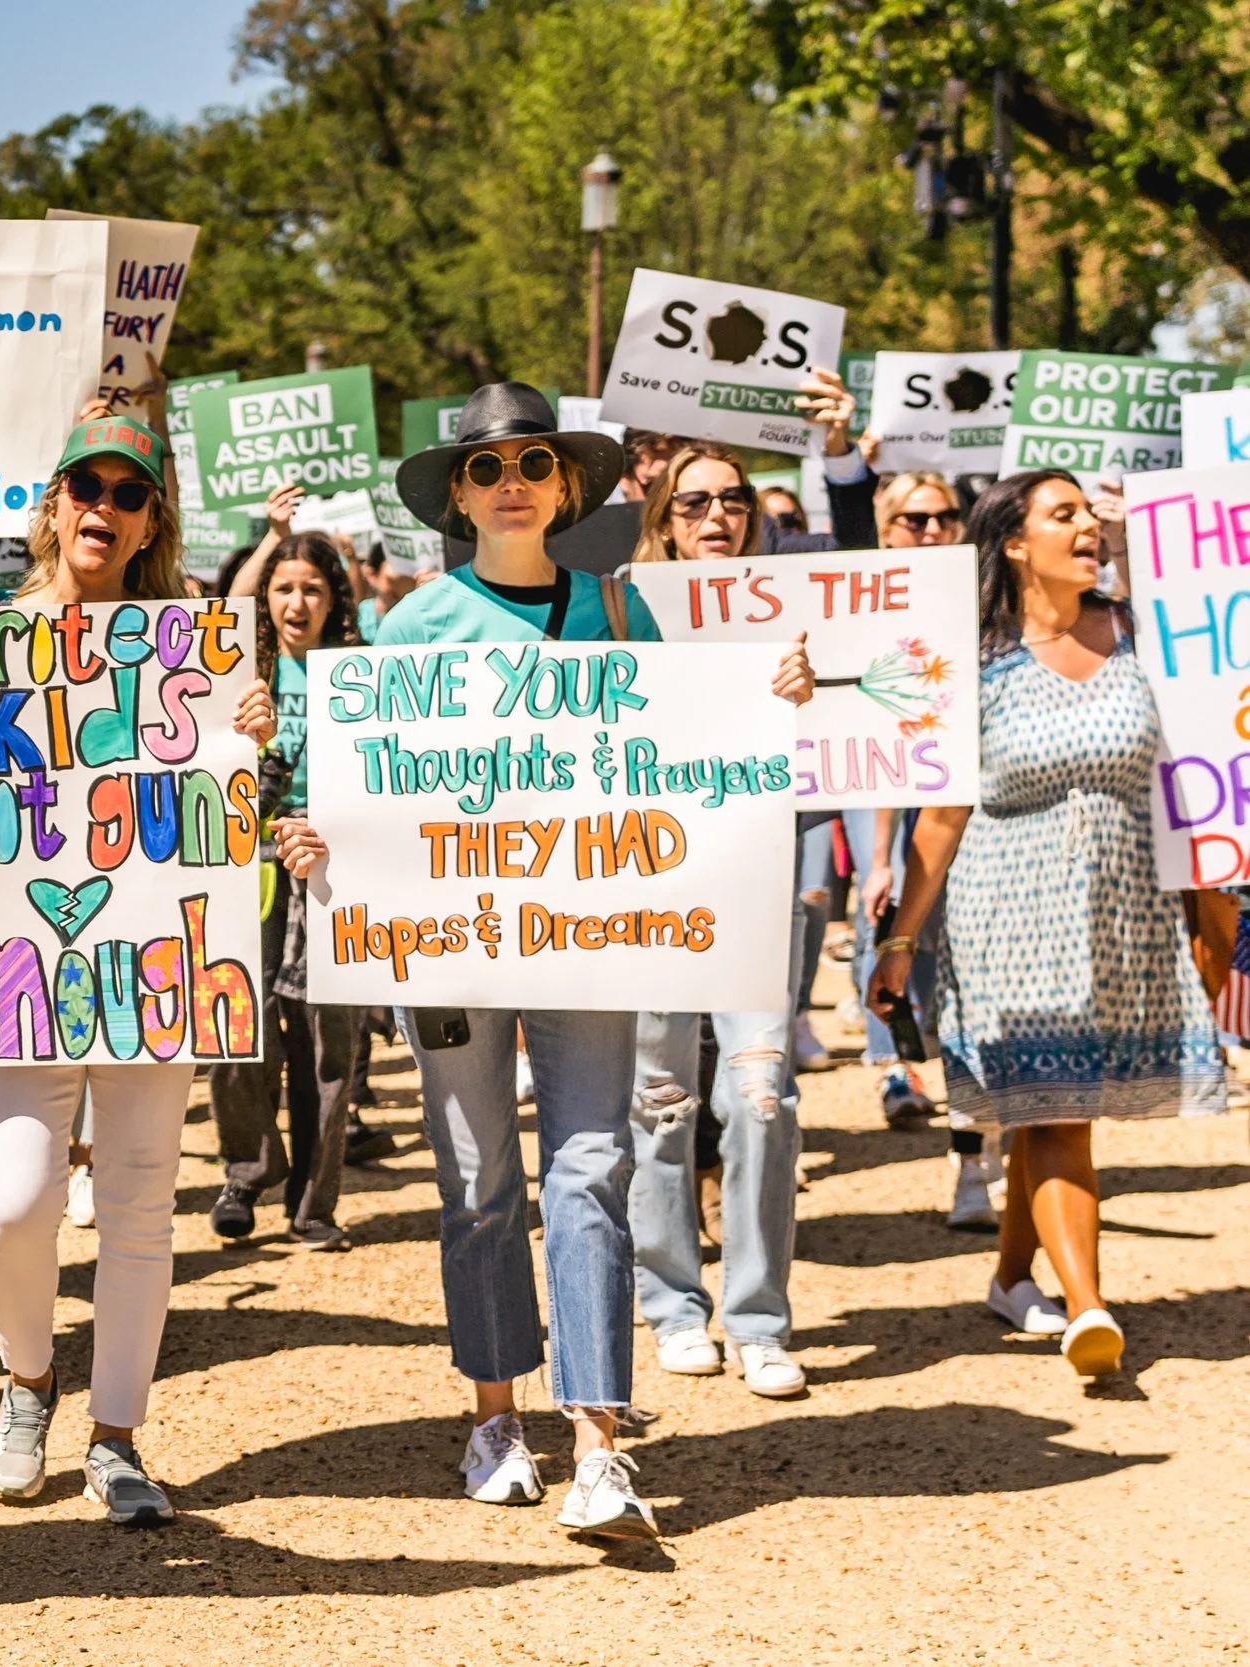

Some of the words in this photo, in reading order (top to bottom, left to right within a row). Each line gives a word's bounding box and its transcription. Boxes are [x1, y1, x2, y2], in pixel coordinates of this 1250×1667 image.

[116, 259, 185, 301] HATH
[103, 310, 165, 344] FURY
[619, 371, 661, 391] Save
[667, 380, 699, 397] Our
[703, 384, 815, 415] STUDEN
[1034, 360, 1219, 398] PROTECT
[241, 391, 320, 428] BAN
[1029, 394, 1118, 428] OUR
[1126, 400, 1181, 430] KID
[215, 424, 358, 469] ASSAULT
[758, 429, 808, 447] FOURTH
[1023, 440, 1101, 468] NOT
[207, 453, 372, 500] WEAPONS
[688, 567, 782, 629] IT'S
[808, 566, 910, 620] THE
[328, 649, 466, 724] SAVE
[485, 643, 649, 725] YOUR
[354, 731, 576, 815] Thoughts
[624, 736, 792, 810] Prayers
[86, 768, 259, 871] guns
[420, 816, 566, 880] THEY
[575, 808, 688, 881] HAD
[331, 902, 469, 983] Hopes
[520, 901, 716, 958] Dreams
